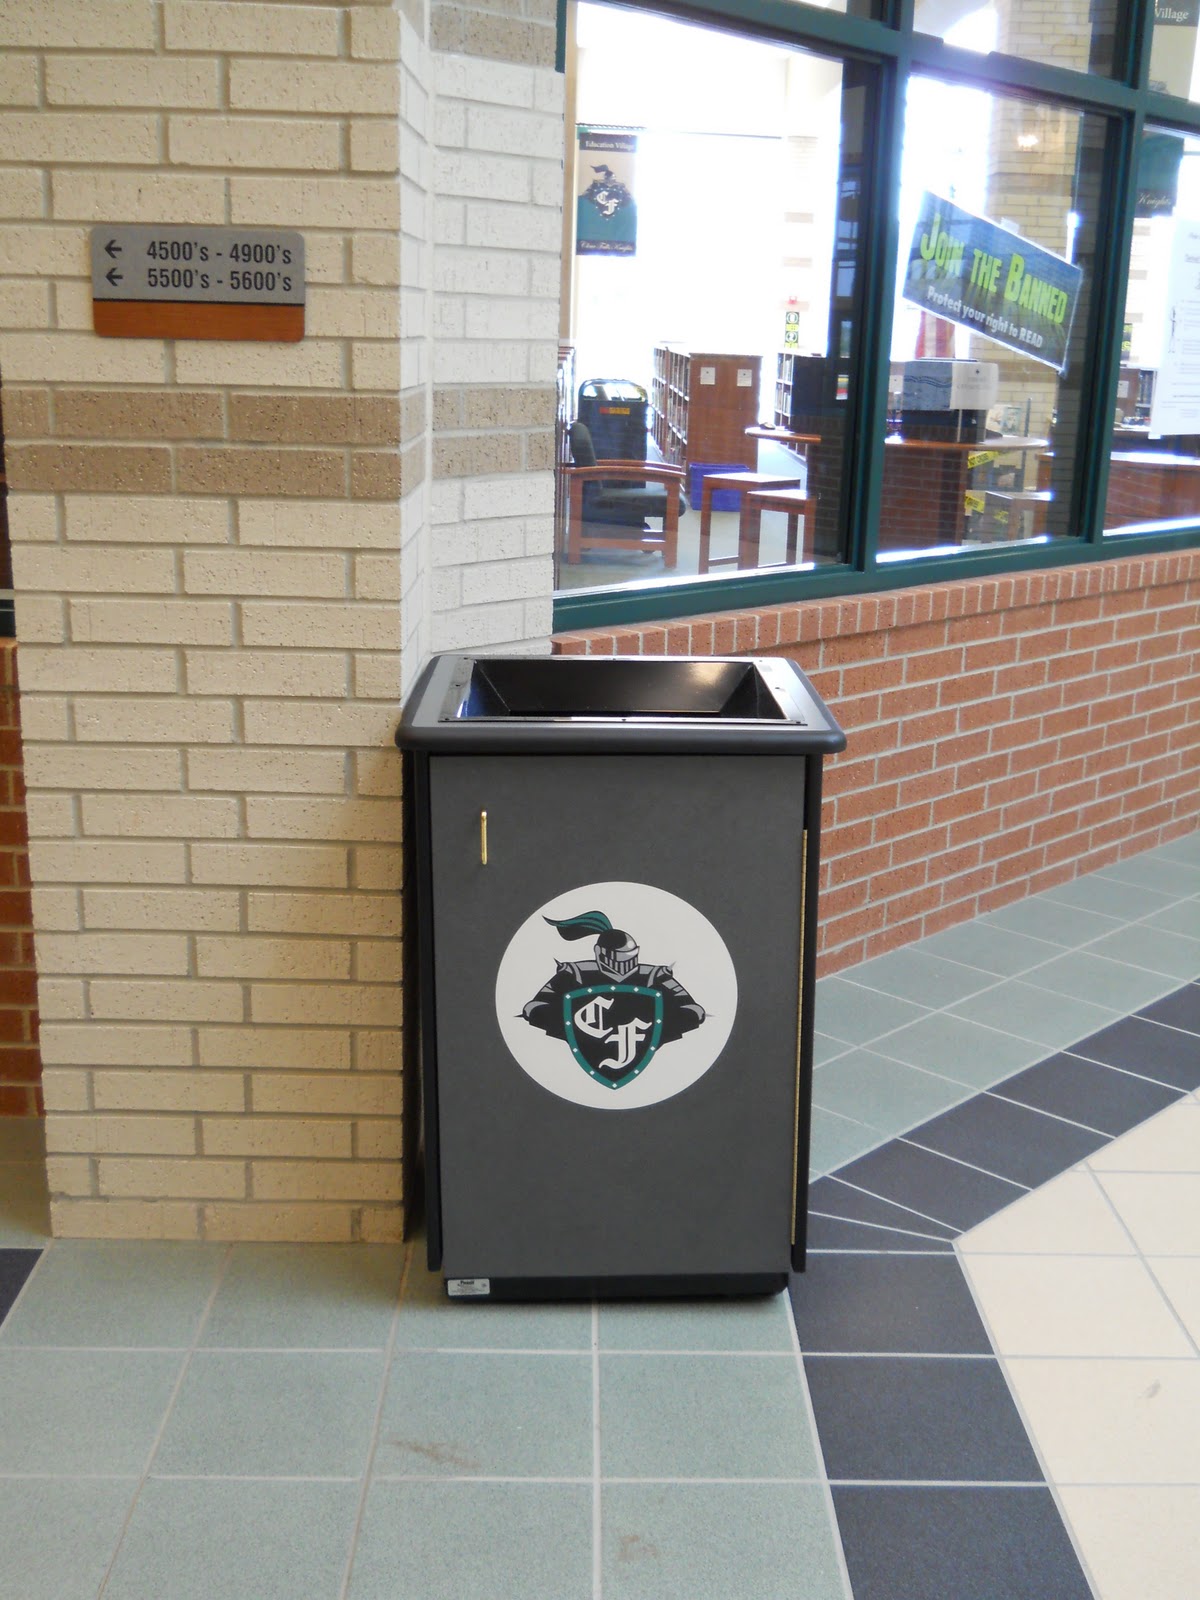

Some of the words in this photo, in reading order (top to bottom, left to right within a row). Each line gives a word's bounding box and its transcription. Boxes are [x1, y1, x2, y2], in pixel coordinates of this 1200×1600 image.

[1154, 7, 1189, 22] Village
[146, 241, 209, 262] 4500's
[229, 243, 292, 265] 4900's
[147, 268, 210, 289] 5500's
[230, 270, 292, 292] 5600's
[927, 285, 963, 313] Protect
[962, 305, 987, 323] your
[985, 312, 1009, 333] right
[1009, 323, 1019, 338] to
[1018, 327, 1043, 349] READ
